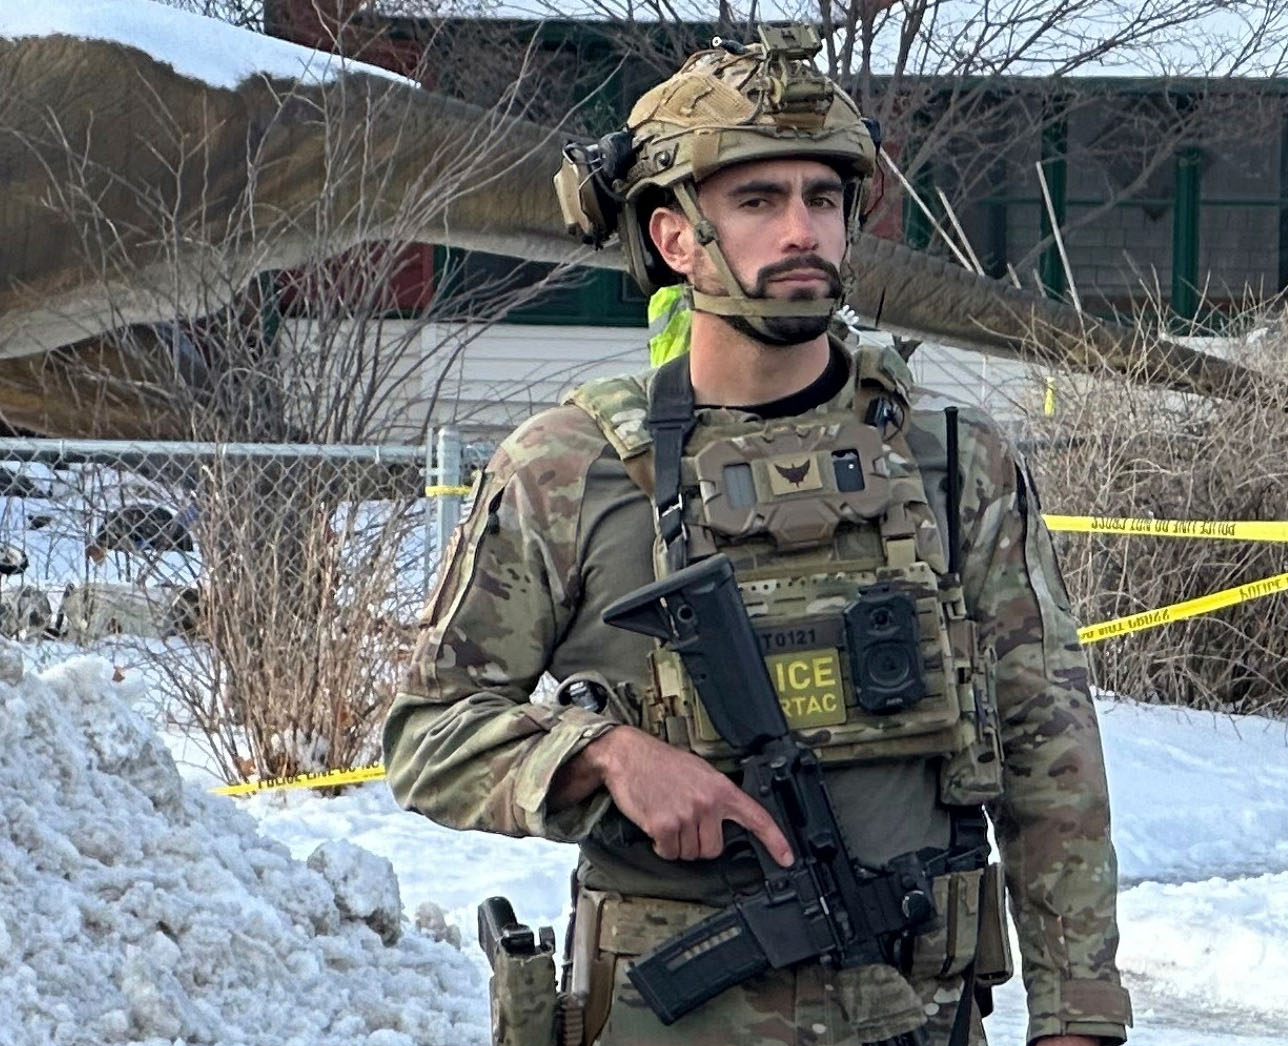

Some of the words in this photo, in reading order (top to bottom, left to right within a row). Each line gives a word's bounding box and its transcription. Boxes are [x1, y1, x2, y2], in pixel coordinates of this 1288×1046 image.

[1154, 518, 1169, 533] DO
[1172, 519, 1197, 534] LINE
[1199, 519, 1236, 536] POLICE
[775, 657, 836, 692] ICE
[781, 693, 837, 718] RTAC
